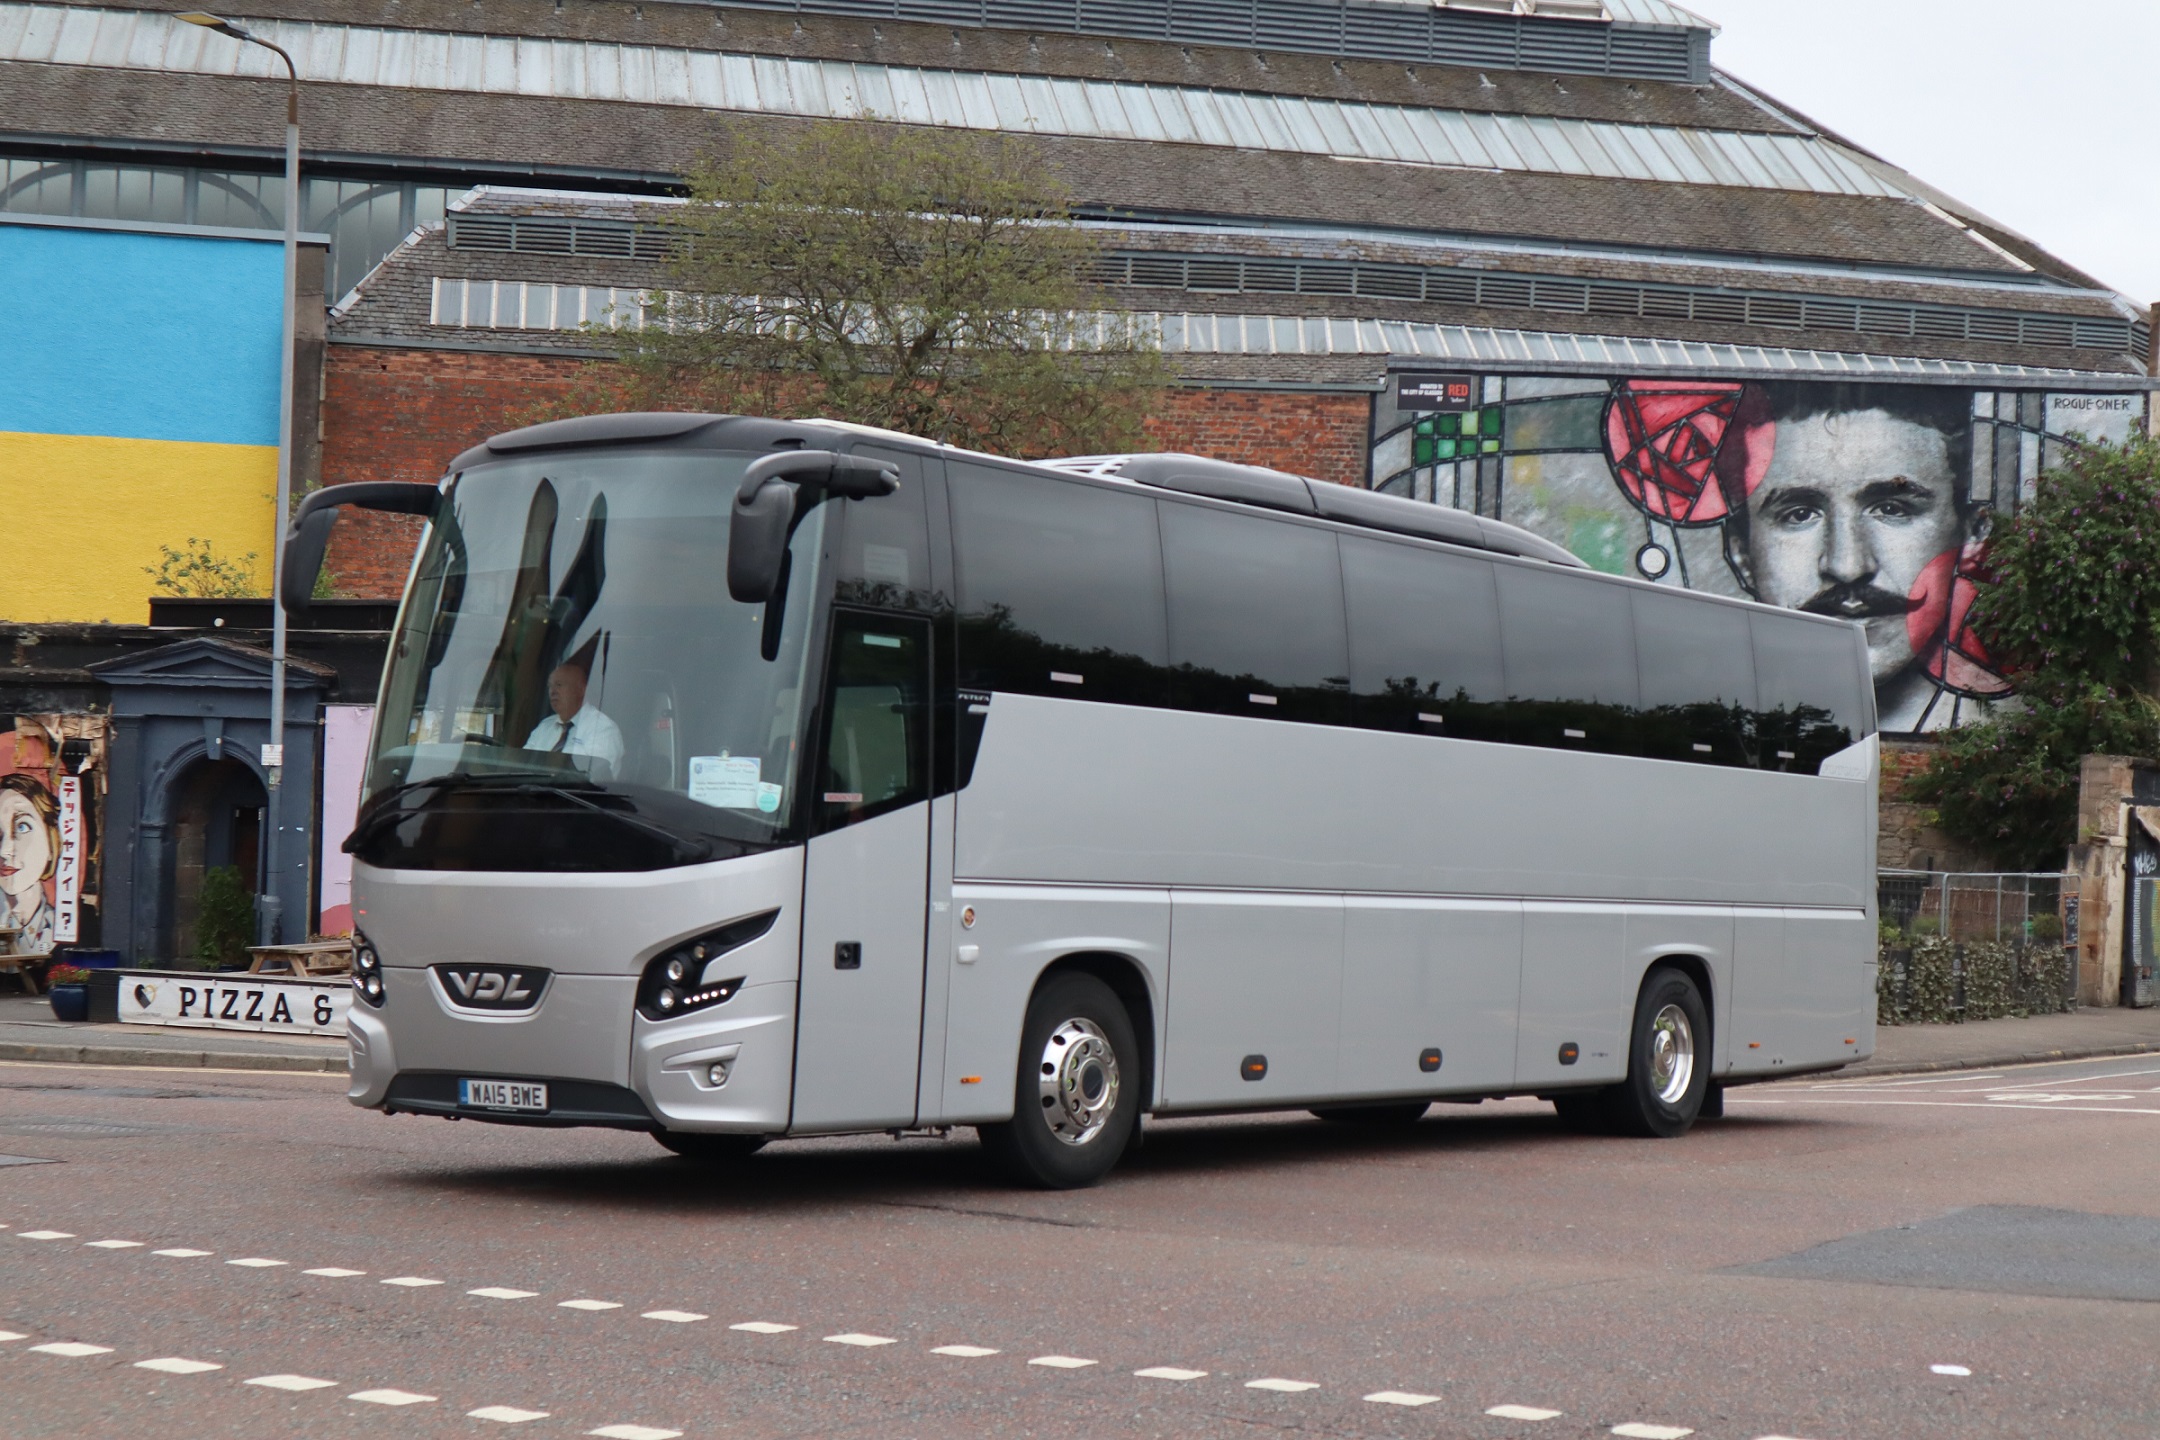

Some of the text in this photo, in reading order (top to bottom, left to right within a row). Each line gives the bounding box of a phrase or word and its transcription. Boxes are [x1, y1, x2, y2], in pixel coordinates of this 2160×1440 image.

[1448, 384, 1468, 396] RED
[2054, 398, 2130, 410] ROGUE ONER
[448, 972, 531, 1001] VDL
[178, 986, 333, 1026] PIZZA &
[472, 1083, 542, 1107] WA15 BWE
